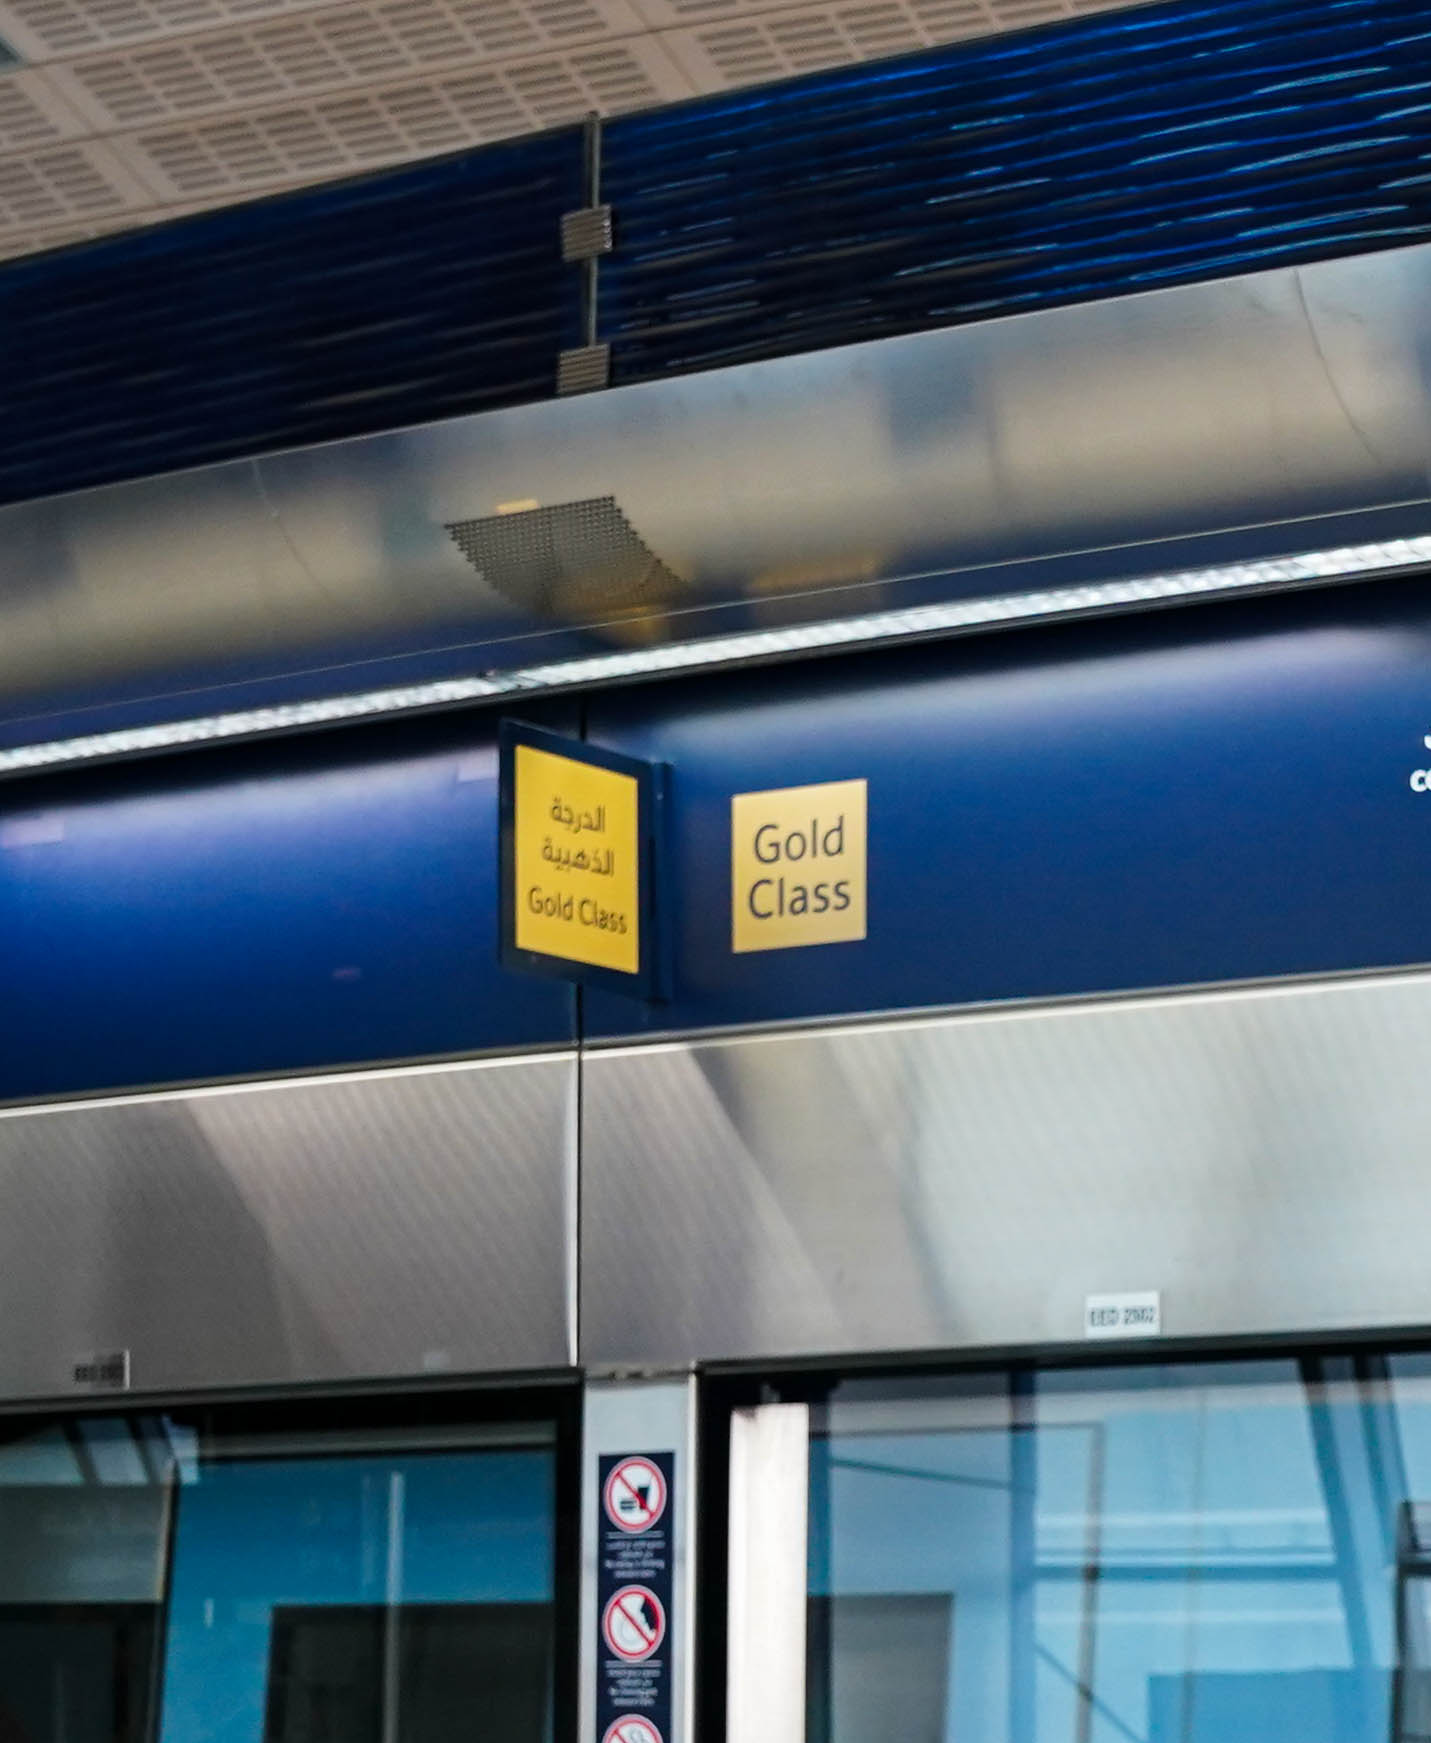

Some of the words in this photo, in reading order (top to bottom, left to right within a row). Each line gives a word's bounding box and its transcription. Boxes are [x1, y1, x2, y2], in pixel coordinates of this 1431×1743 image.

[550, 796, 607, 835] الدرجة
[540, 837, 615, 878] الذهبية
[754, 813, 845, 865] Gold
[528, 886, 575, 923] Gold
[578, 894, 628, 937] Class
[748, 877, 851, 921] Class
